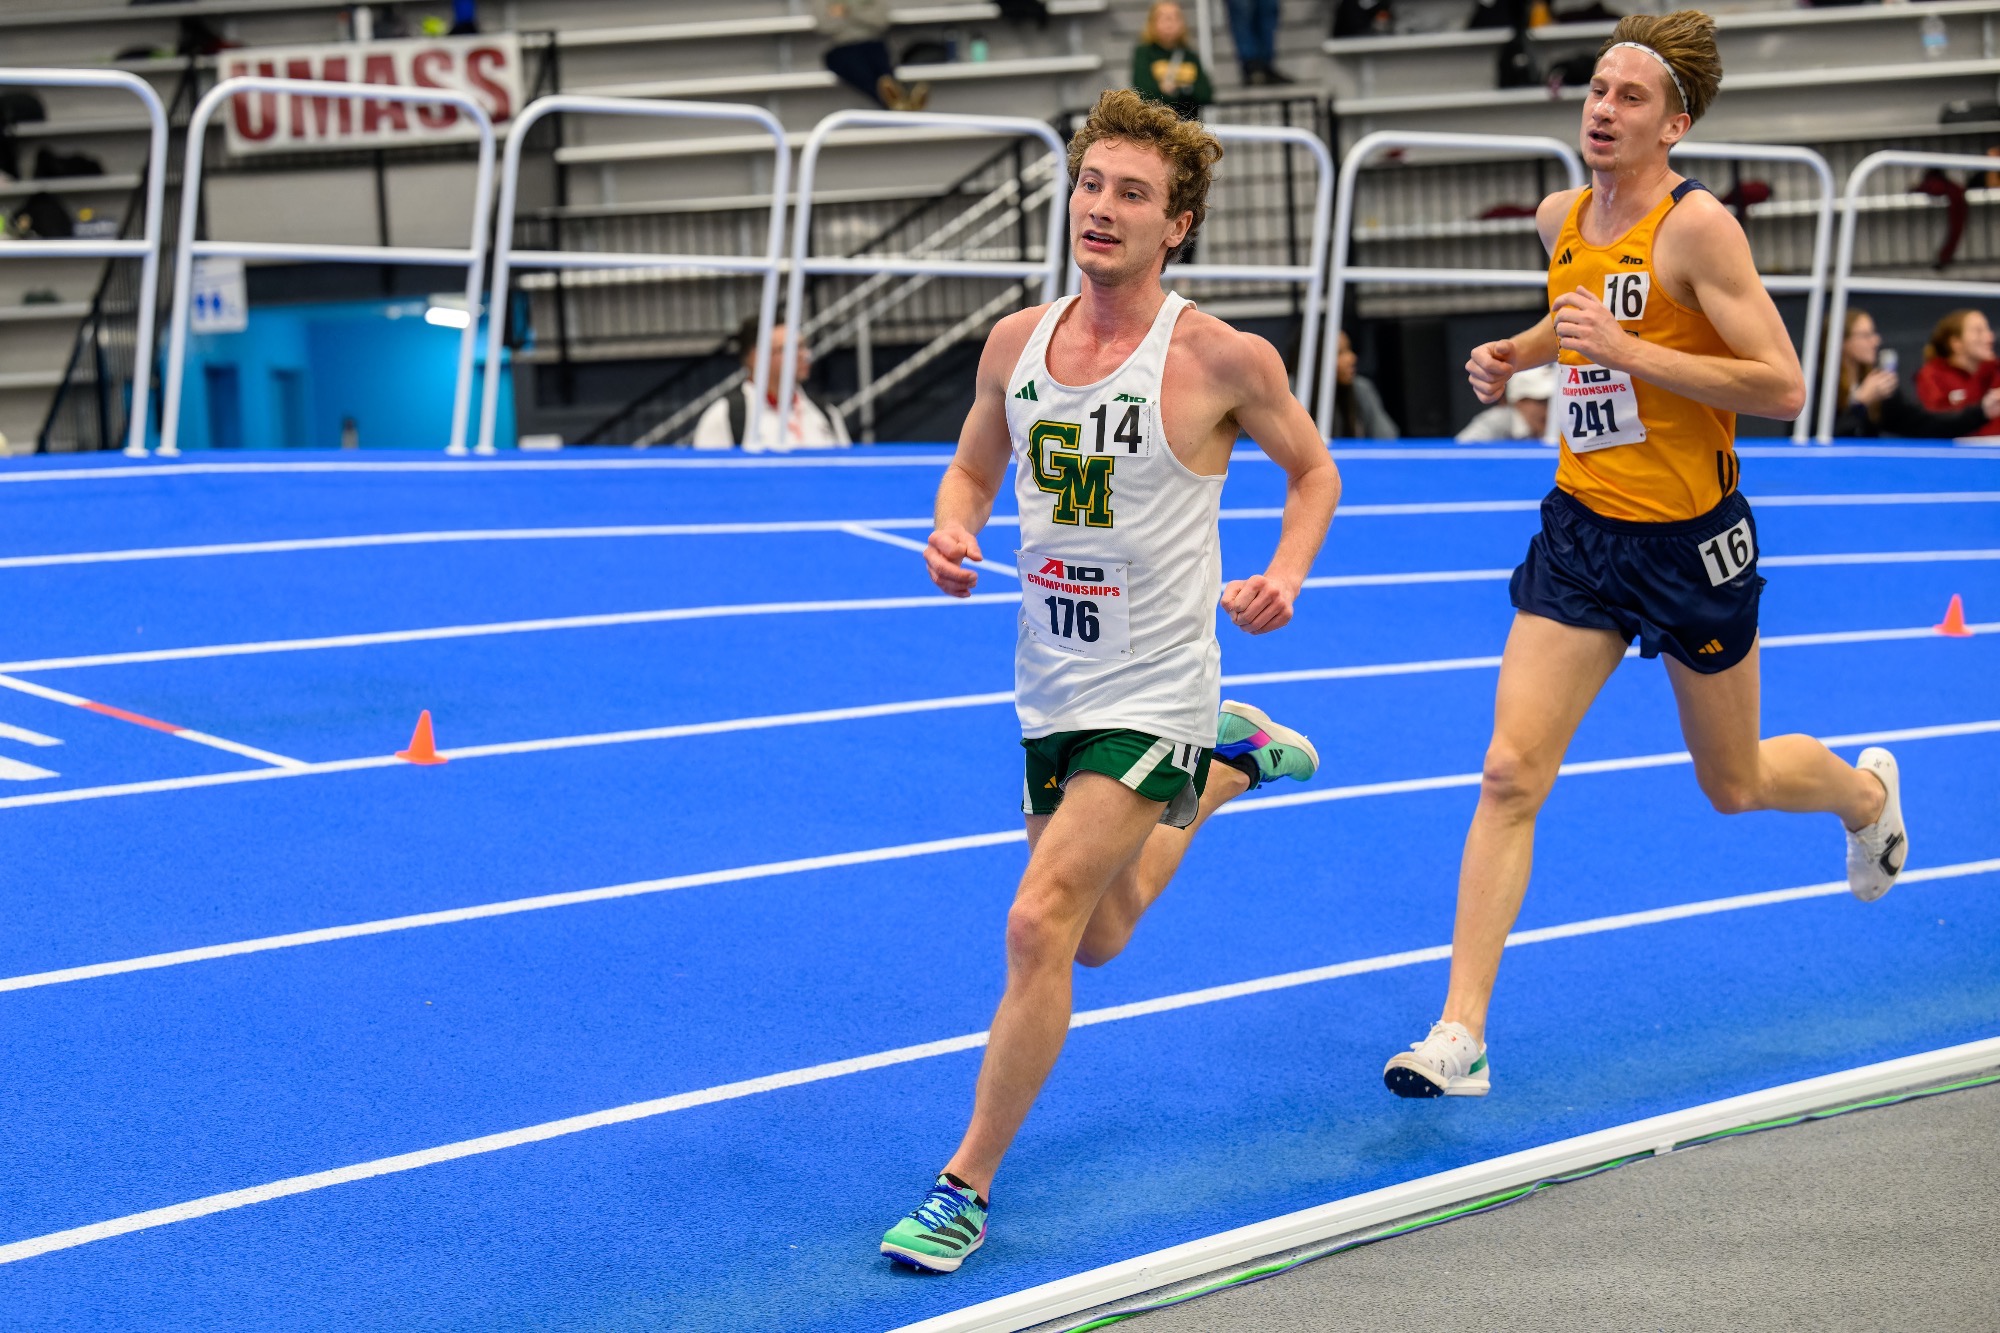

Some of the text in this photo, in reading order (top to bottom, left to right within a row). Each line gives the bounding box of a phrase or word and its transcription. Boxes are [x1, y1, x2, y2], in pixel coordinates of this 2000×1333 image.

[231, 47, 511, 142] UMASS
[1619, 255, 1643, 265] A10
[1607, 274, 1643, 318] 16
[1568, 368, 1611, 385] A10
[1112, 393, 1147, 403] A10
[1569, 399, 1620, 438] 241
[1090, 404, 1142, 453] 14
[1027, 419, 1115, 528] GM
[1039, 557, 1104, 582] A10
[1705, 527, 1748, 579] 16
[1027, 573, 1120, 597] CHAMPIONSHIPS
[1045, 595, 1100, 643] 176
